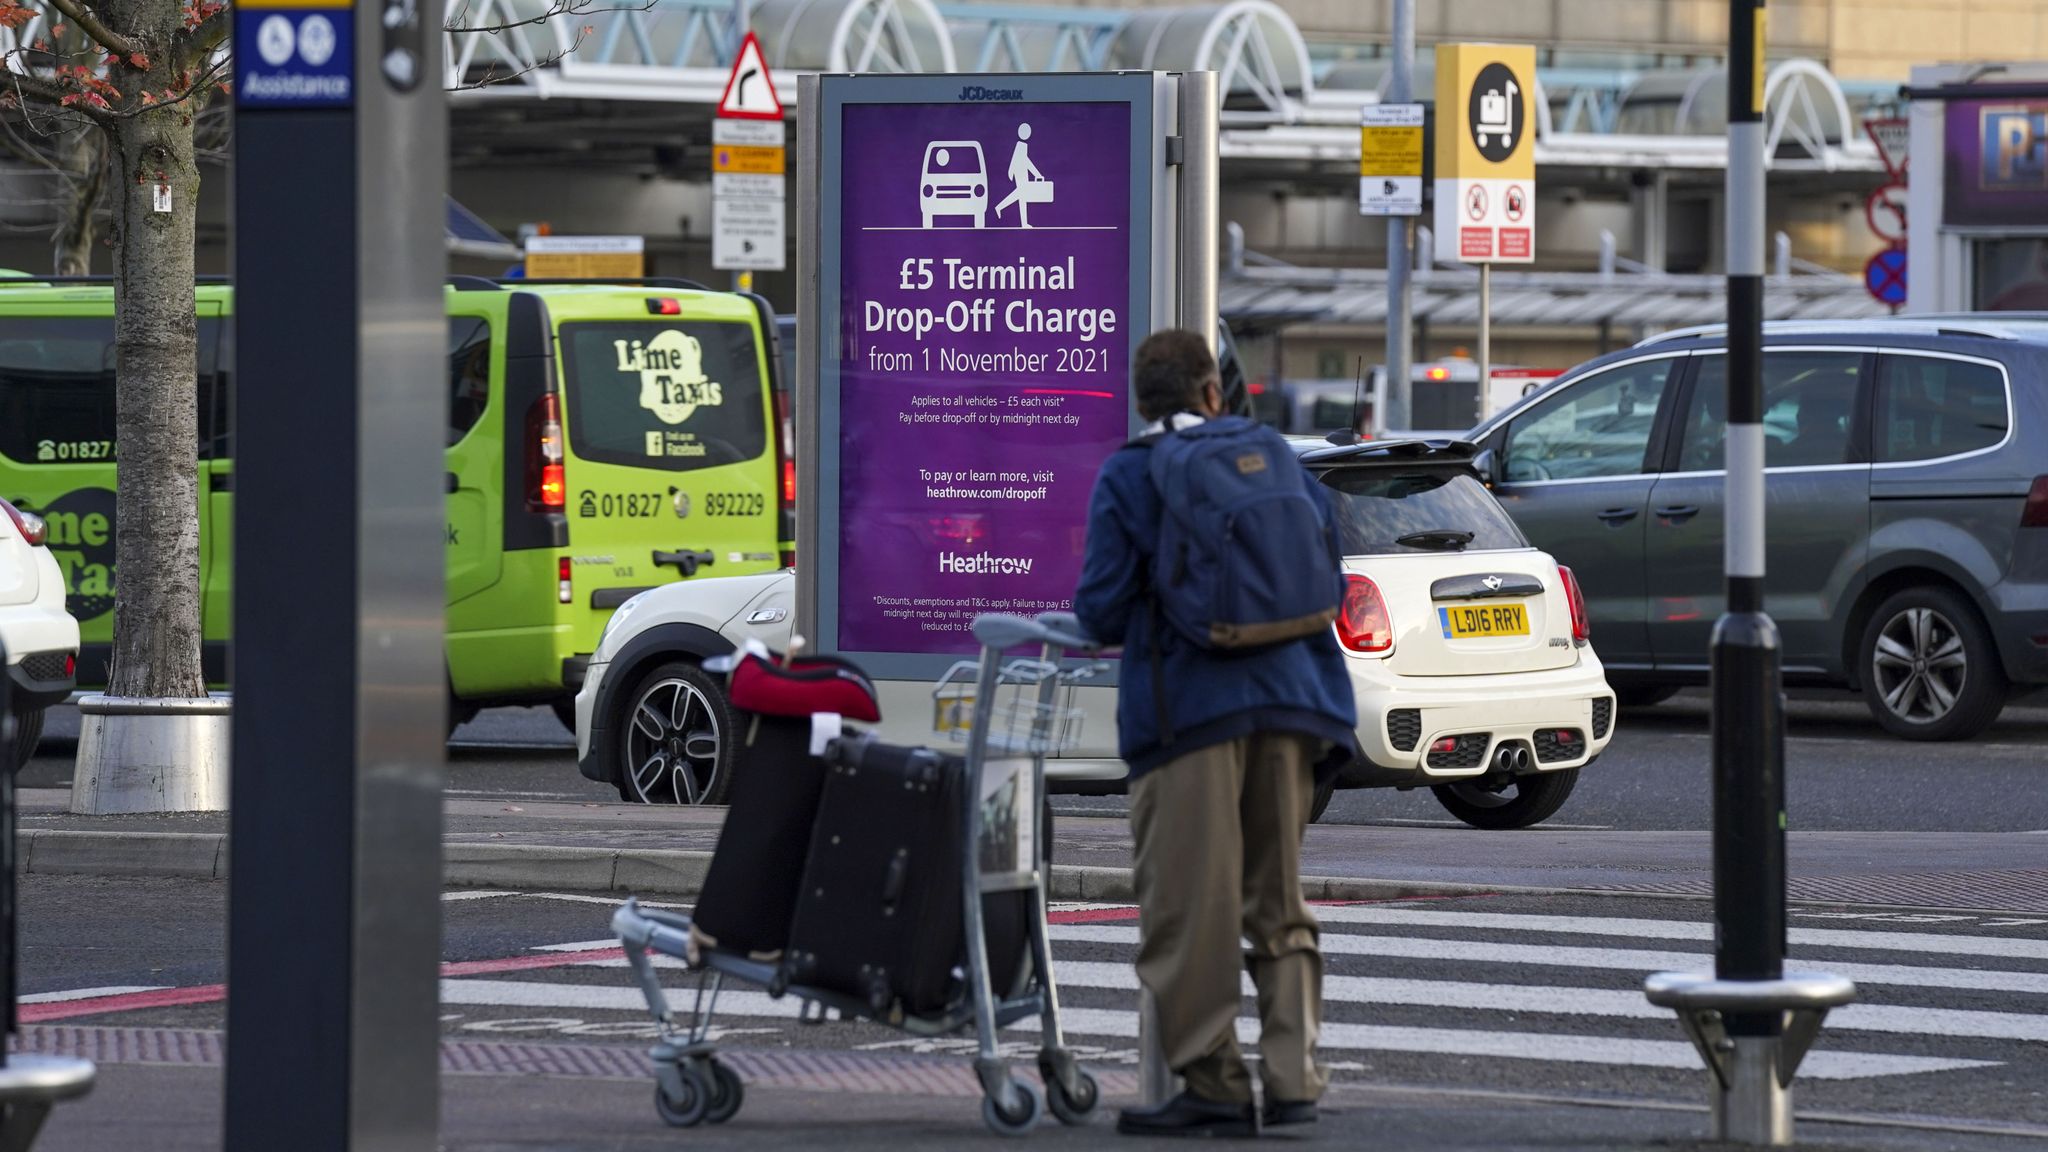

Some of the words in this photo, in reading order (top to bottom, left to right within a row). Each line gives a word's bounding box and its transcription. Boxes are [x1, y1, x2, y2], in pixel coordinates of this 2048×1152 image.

[242, 72, 350, 97] Assistance
[959, 86, 1023, 100] JCDecaux
[900, 258, 933, 289] £5
[943, 256, 1074, 289] Terminal
[866, 299, 995, 340] Drop-Off
[1005, 299, 1116, 341] Charge
[614, 340, 682, 371] Lime
[869, 346, 912, 371] from
[922, 348, 929, 371] 1
[941, 347, 1048, 372] November
[1056, 348, 1108, 373] 2021
[656, 374, 723, 407] Taxis
[912, 395, 941, 408] Applies
[943, 397, 952, 406] to
[954, 395, 963, 406] all
[965, 396, 998, 407] vehicles
[1008, 396, 1019, 407] £5
[1021, 396, 1041, 407] each
[900, 412, 913, 425] Pay
[915, 412, 941, 423] before
[942, 412, 977, 425] drop-off
[979, 415, 988, 424] or
[990, 413, 1001, 426] by
[1003, 413, 1041, 426] midnight
[1043, 415, 1062, 424] next
[1064, 413, 1080, 427] day
[57, 441, 111, 458] 01827
[920, 469, 932, 481] To
[935, 472, 953, 484] pay
[956, 472, 968, 482] or
[970, 469, 997, 482] learn
[1000, 473, 1030, 484] more,
[1033, 471, 1055, 483] visit
[927, 486, 1046, 501] heathrow.com/dropoff
[602, 494, 662, 517] 01827
[705, 493, 764, 516] 892229
[940, 551, 1032, 574] Heathrow
[884, 608, 914, 621] midnight
[917, 610, 931, 619] next
[934, 610, 946, 621] day
[948, 609, 960, 619] will
[914, 599, 954, 610] exemptions
[956, 598, 969, 606] and
[972, 598, 989, 606] T&Cs
[991, 599, 1012, 610] apply.
[1013, 599, 1035, 608] Failure
[1037, 600, 1044, 608] to
[1046, 601, 1059, 611] pay
[1061, 600, 1070, 609] £5
[921, 621, 952, 633] (reduced
[954, 623, 962, 632] to
[964, 622, 975, 632] £4
[1454, 609, 1491, 633] LD16
[1493, 607, 1521, 631] RRY
